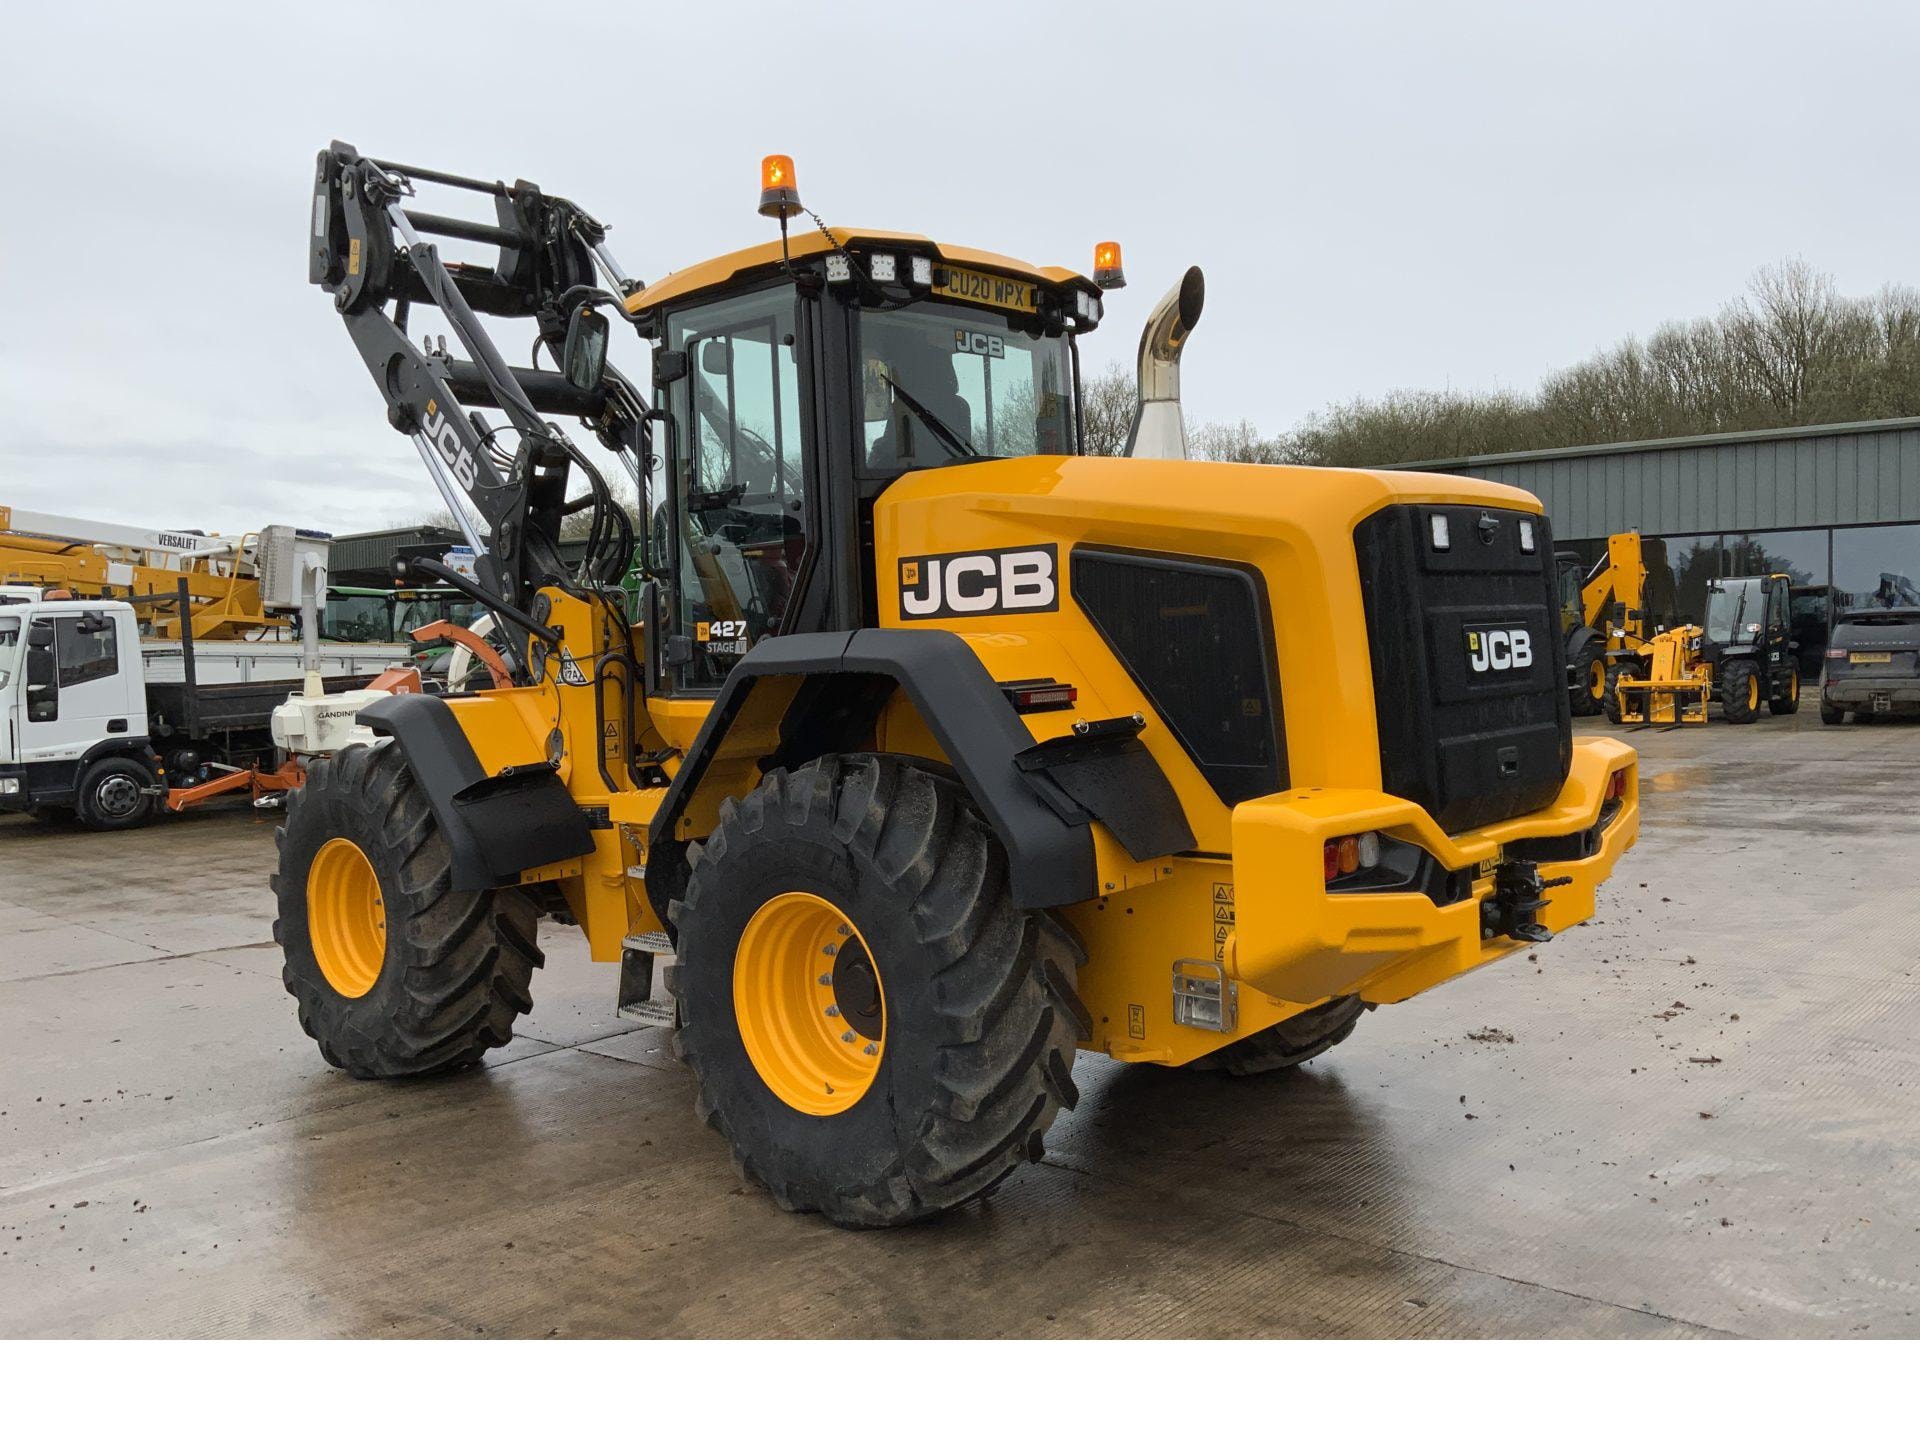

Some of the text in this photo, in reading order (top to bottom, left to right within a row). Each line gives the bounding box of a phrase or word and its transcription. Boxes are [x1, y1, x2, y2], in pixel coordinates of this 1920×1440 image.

[949, 270, 1024, 307] CU20 WPX
[956, 331, 1004, 357] JCB
[422, 410, 479, 492] JCB
[158, 533, 198, 550] VERSALIFT
[903, 551, 1055, 615] JCB
[710, 620, 747, 637] 427
[707, 642, 734, 653] STAGE
[1471, 630, 1533, 672] JCB
